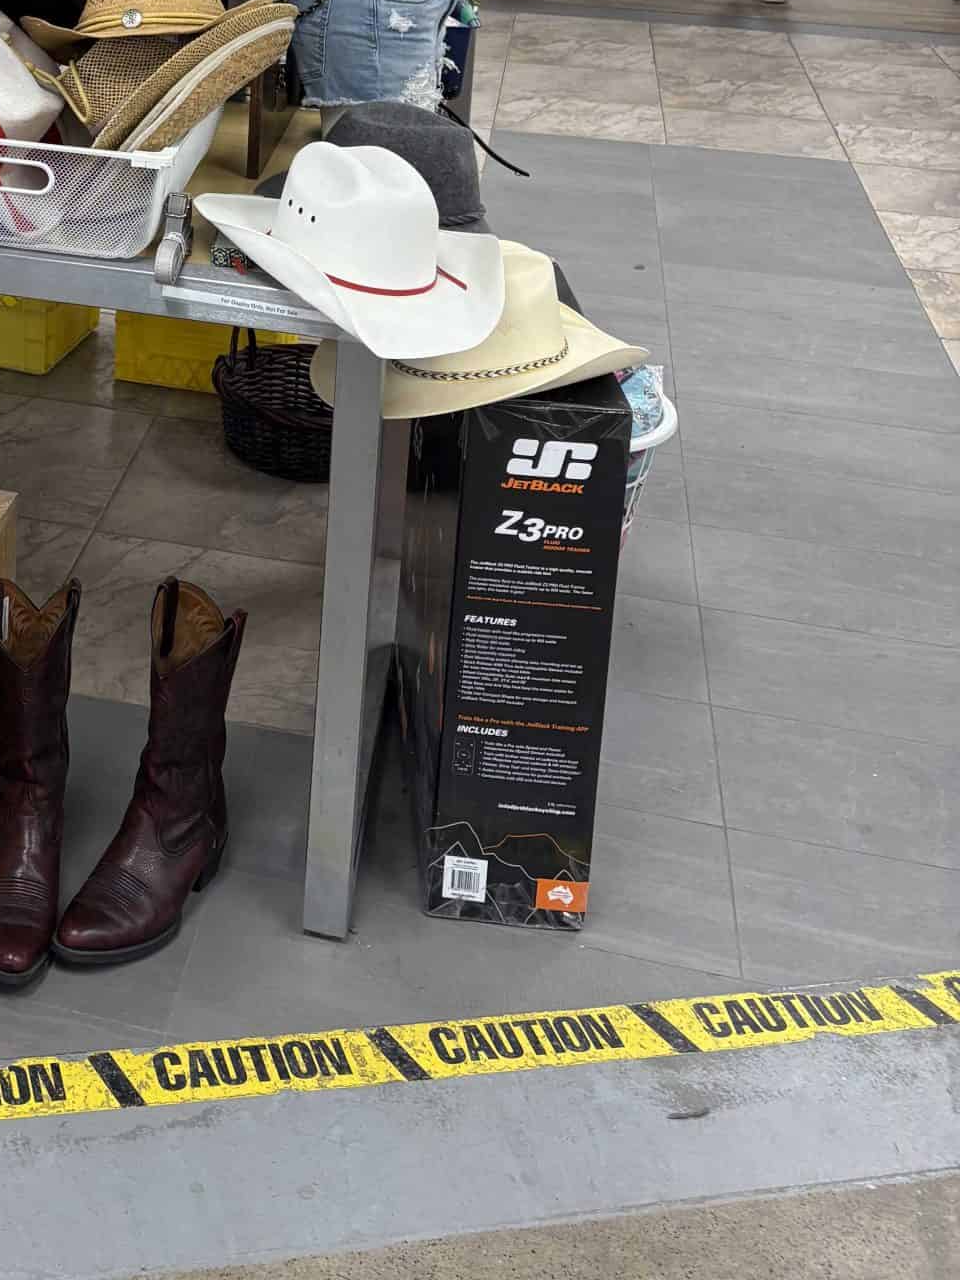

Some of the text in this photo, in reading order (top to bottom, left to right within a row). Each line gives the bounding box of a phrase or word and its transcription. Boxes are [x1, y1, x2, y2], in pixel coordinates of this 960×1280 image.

[464, 615, 517, 627] FEATURES
[457, 725, 508, 737] INCLUDES
[152, 1037, 353, 1091] CAUTION
[428, 1013, 625, 1066] CAUTION
[694, 990, 884, 1039] CAUTION
